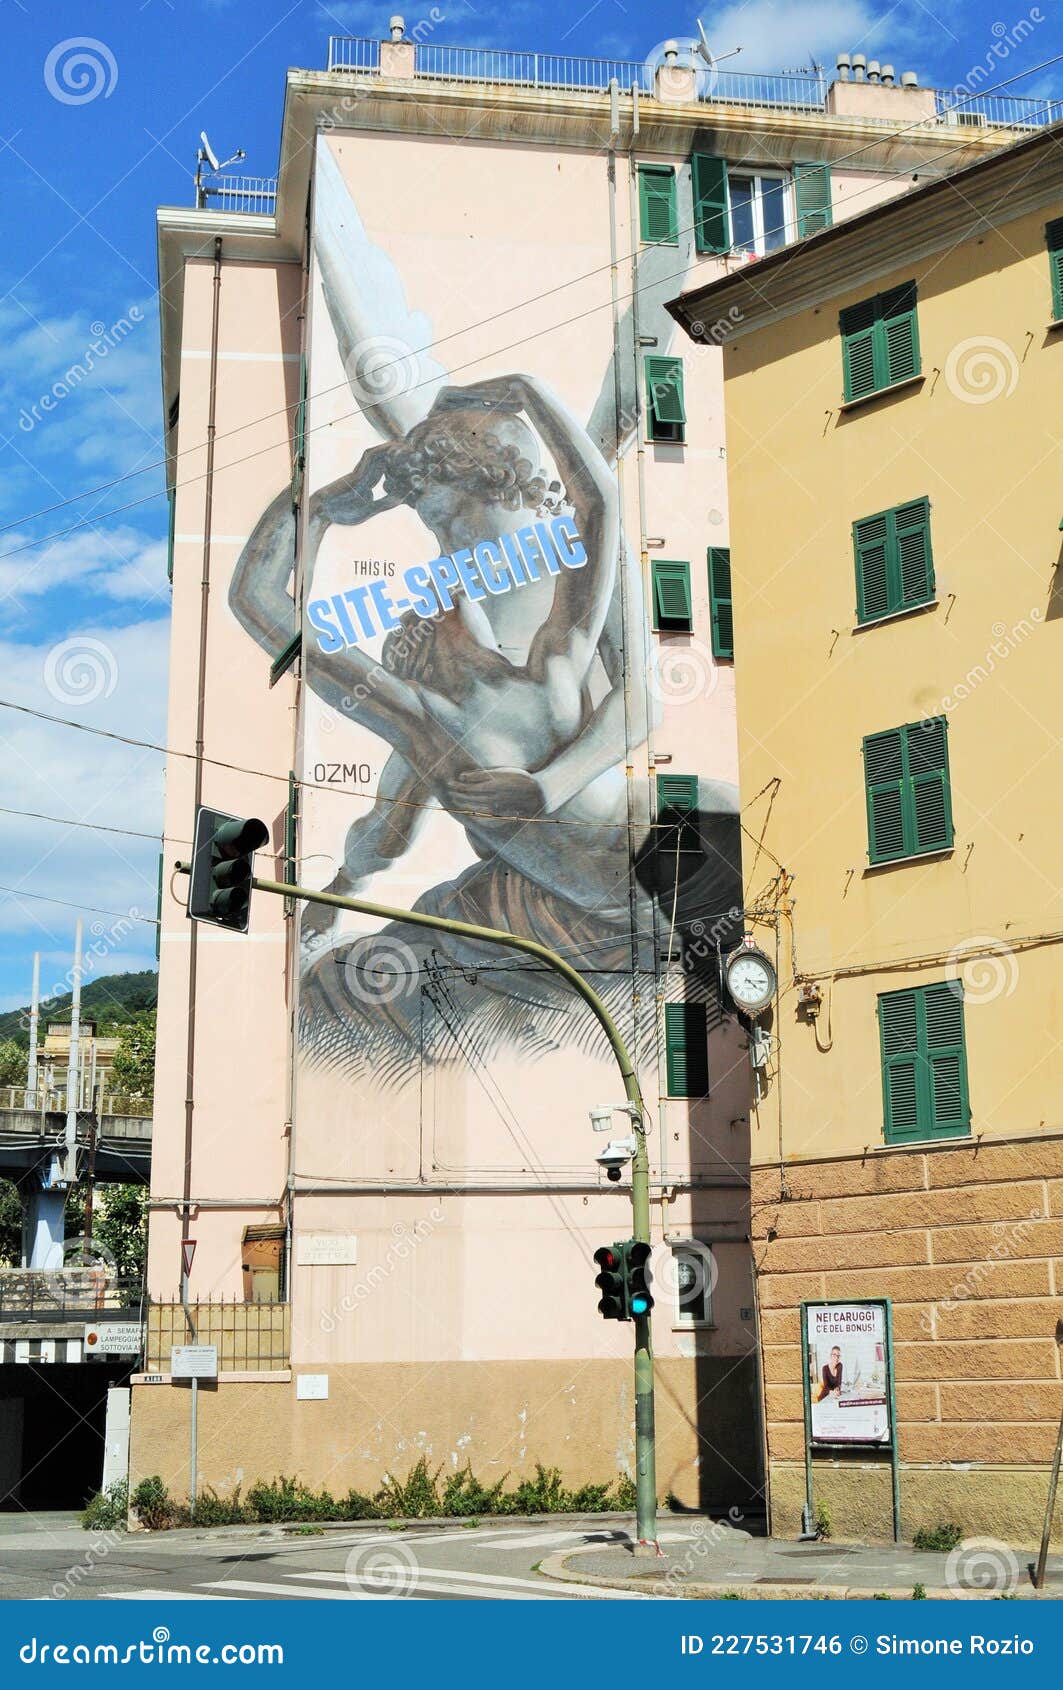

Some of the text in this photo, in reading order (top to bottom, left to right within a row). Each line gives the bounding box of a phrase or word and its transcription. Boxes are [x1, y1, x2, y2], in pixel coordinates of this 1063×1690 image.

[353, 558, 395, 577] THIS IS
[307, 515, 588, 655] SITE-SPECIFIC
[314, 763, 371, 784] OZMO
[816, 1311, 875, 1323] NEI CARUGGI
[830, 1324, 844, 1333] DEL
[846, 1323, 876, 1333] BONUS!
